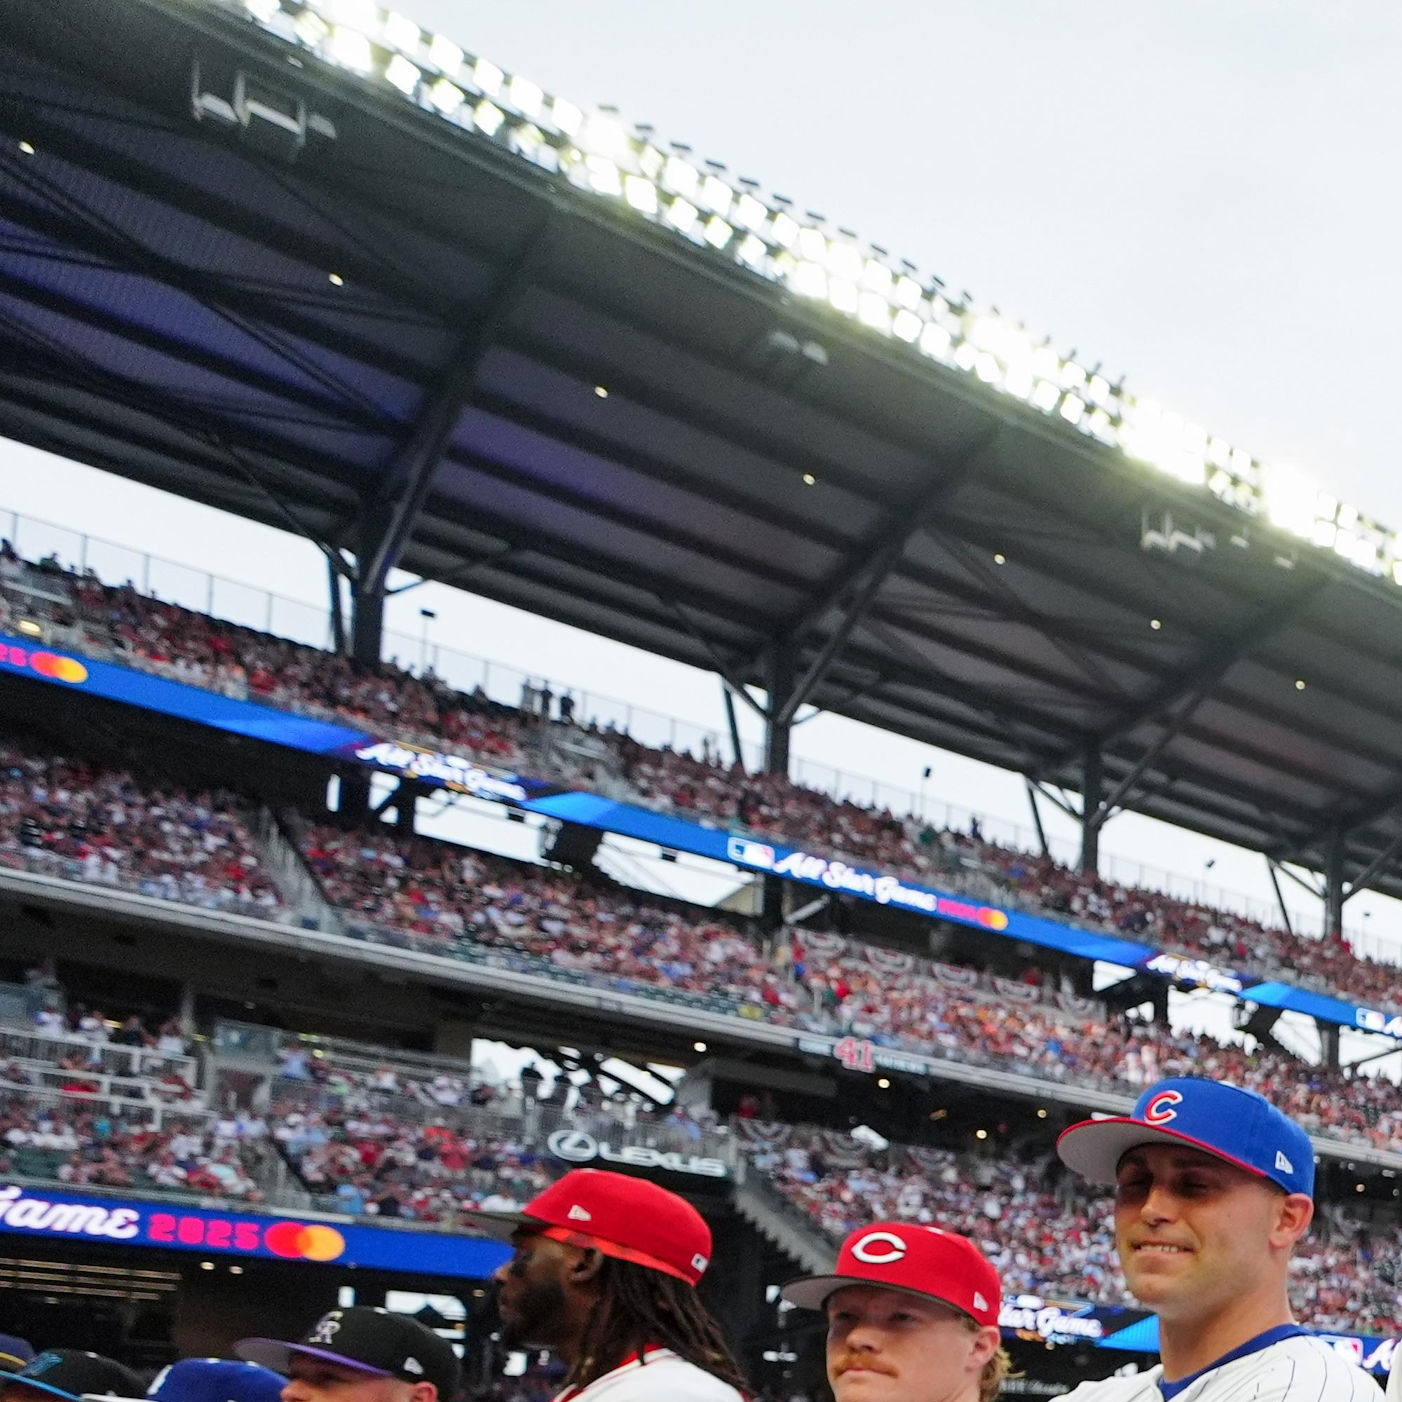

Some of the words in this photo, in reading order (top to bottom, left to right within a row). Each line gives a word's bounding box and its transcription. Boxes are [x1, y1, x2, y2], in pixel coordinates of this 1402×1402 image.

[834, 1037, 875, 1073] 41
[1144, 1090, 1183, 1126] C
[598, 1141, 728, 1178] LEXUS
[148, 1213, 260, 1250] 2025
[850, 1231, 907, 1264] C
